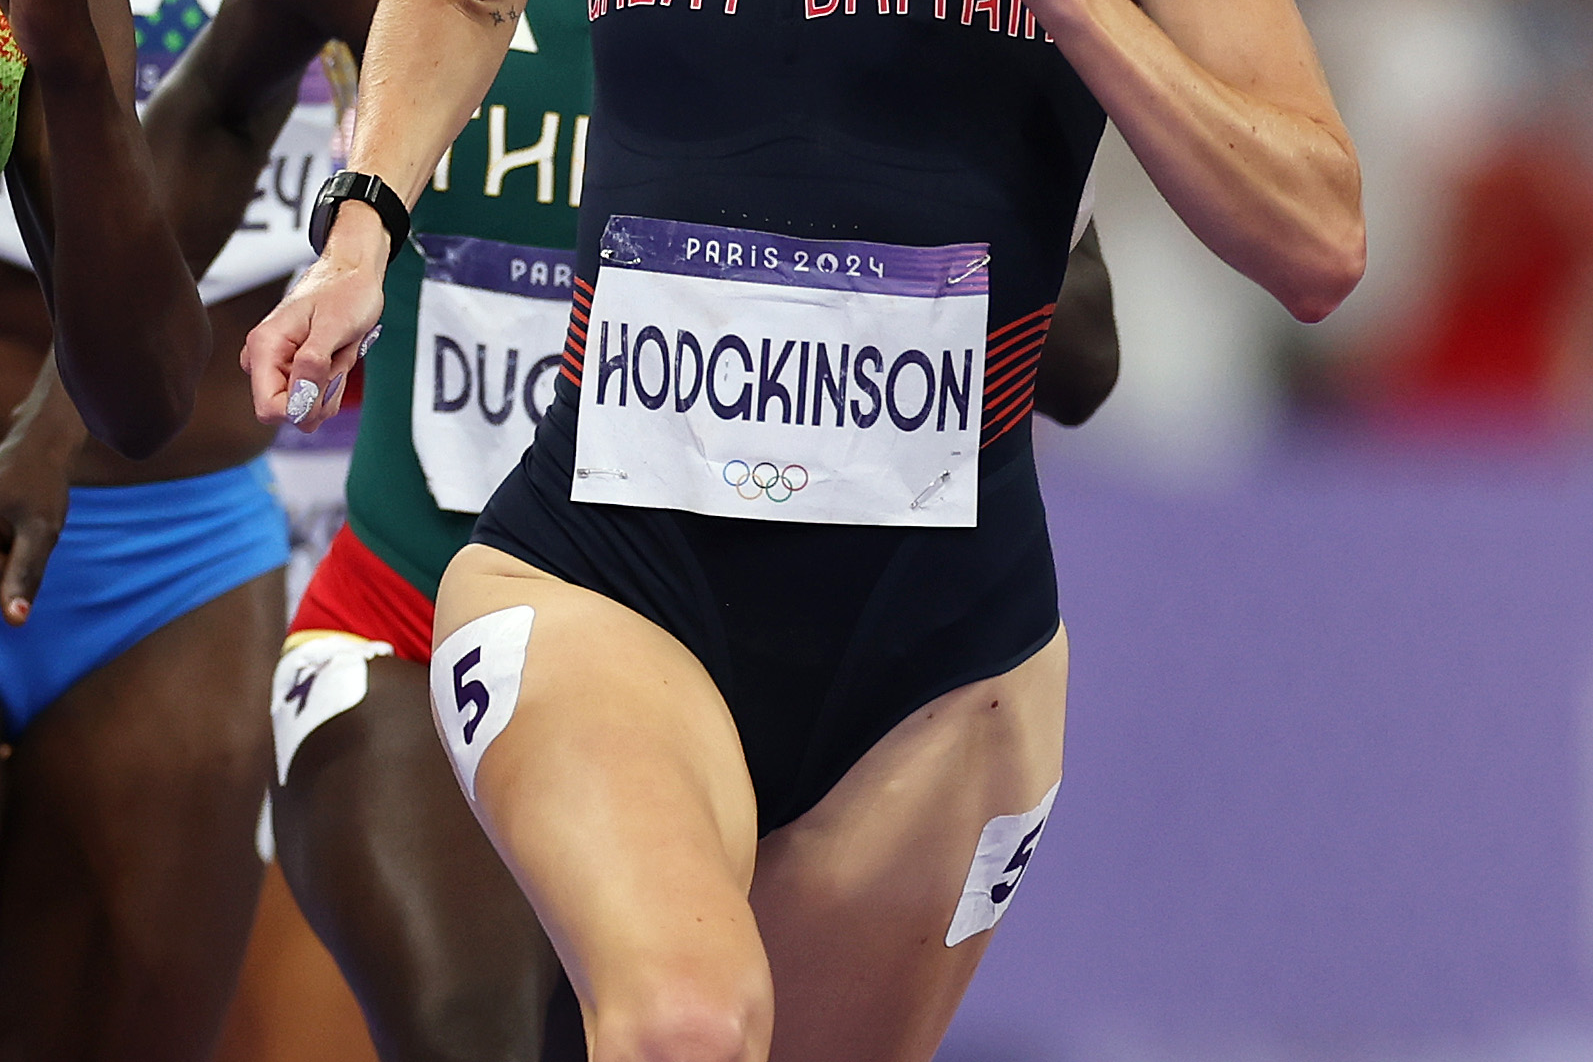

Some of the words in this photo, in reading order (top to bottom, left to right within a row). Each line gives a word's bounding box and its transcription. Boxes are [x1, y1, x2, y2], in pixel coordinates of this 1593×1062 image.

[794, 253, 885, 278] 2024
[595, 321, 973, 432] HODGKINSON
[453, 645, 490, 746] 5
[991, 816, 1046, 905] 5
